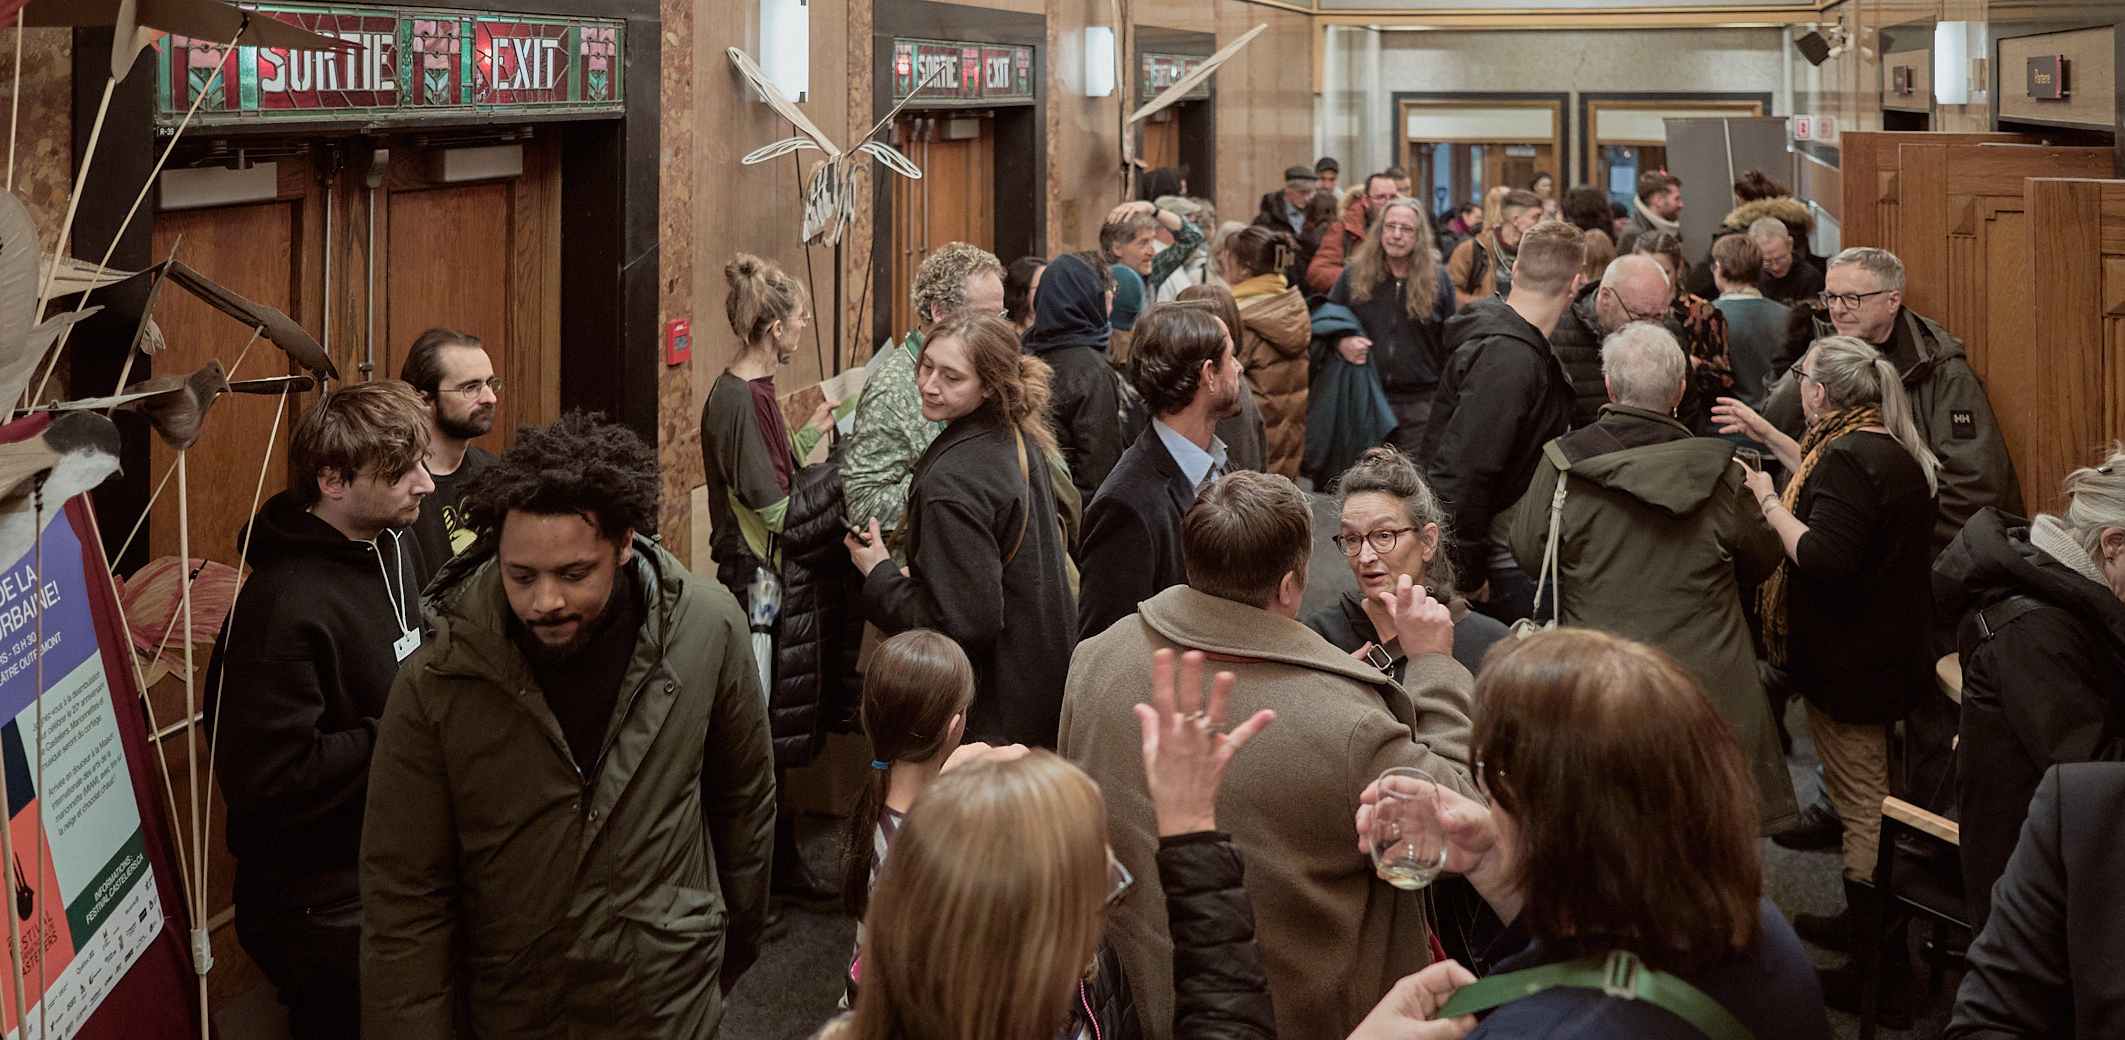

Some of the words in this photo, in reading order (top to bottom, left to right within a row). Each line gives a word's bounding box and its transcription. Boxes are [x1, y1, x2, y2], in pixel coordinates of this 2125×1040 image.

[260, 32, 395, 92] SORTIE
[492, 38, 558, 89] EXIT
[918, 54, 958, 88] SORTIE
[986, 57, 1010, 88] EXIT
[159, 127, 175, 136] R-39
[1953, 414, 1970, 423] HH
[15, 564, 38, 592] LA
[0, 580, 61, 640] RBAINE!
[19, 631, 61, 670] OUTRMONT
[26, 631, 37, 645] 30
